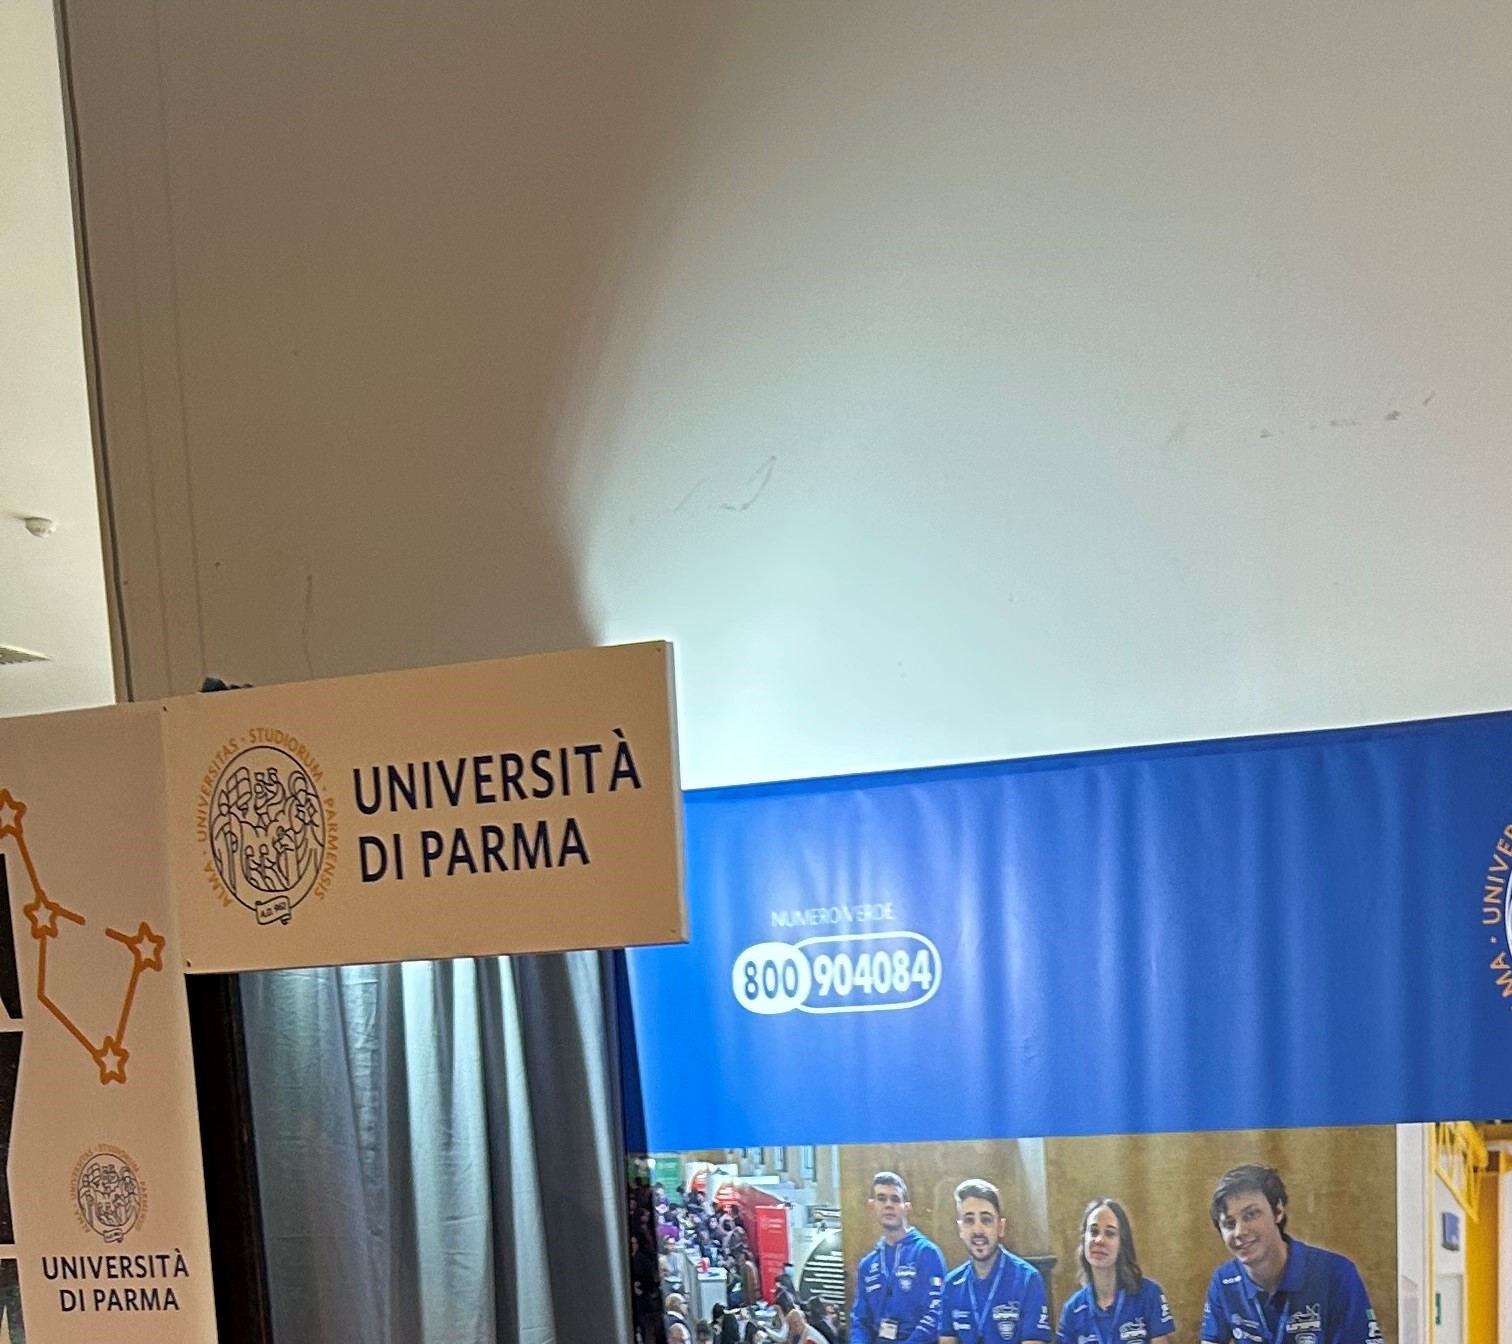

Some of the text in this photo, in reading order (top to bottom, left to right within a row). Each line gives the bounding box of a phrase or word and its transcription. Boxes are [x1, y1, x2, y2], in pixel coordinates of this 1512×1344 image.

[352, 727, 643, 816] UNIVERSITÀ
[197, 727, 339, 908] ALMA UNIVERSITAS STUDIORUM PARMENSIS
[358, 817, 590, 883] DI PARMA
[744, 949, 932, 1001] 800 904084
[41, 1247, 190, 1281] UNIVERSITÀ
[59, 1287, 181, 1312] DI PARMA
